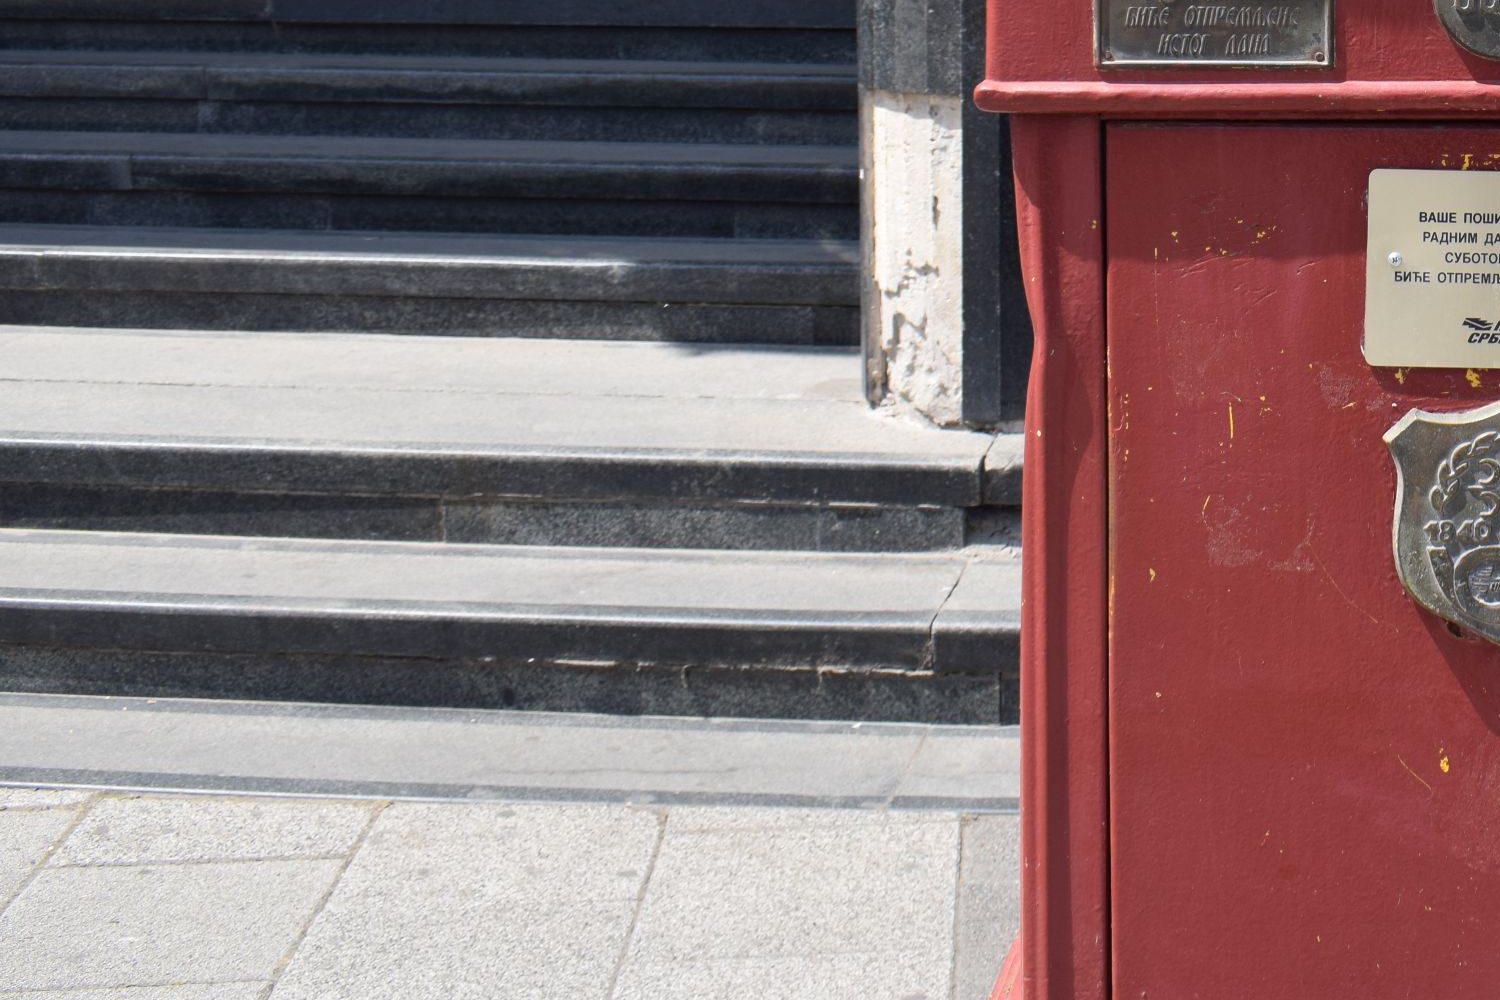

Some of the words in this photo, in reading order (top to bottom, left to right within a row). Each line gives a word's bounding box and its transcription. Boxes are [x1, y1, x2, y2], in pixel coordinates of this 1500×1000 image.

[1125, 6, 1170, 27] БИЋЕ
[1157, 33, 1212, 56] ИСТОГ
[1418, 211, 1457, 223] ВАШЕ
[1422, 231, 1478, 245] РАДНИМ
[1394, 271, 1431, 283] БИЋЕ
[1423, 517, 1491, 543] 1840
